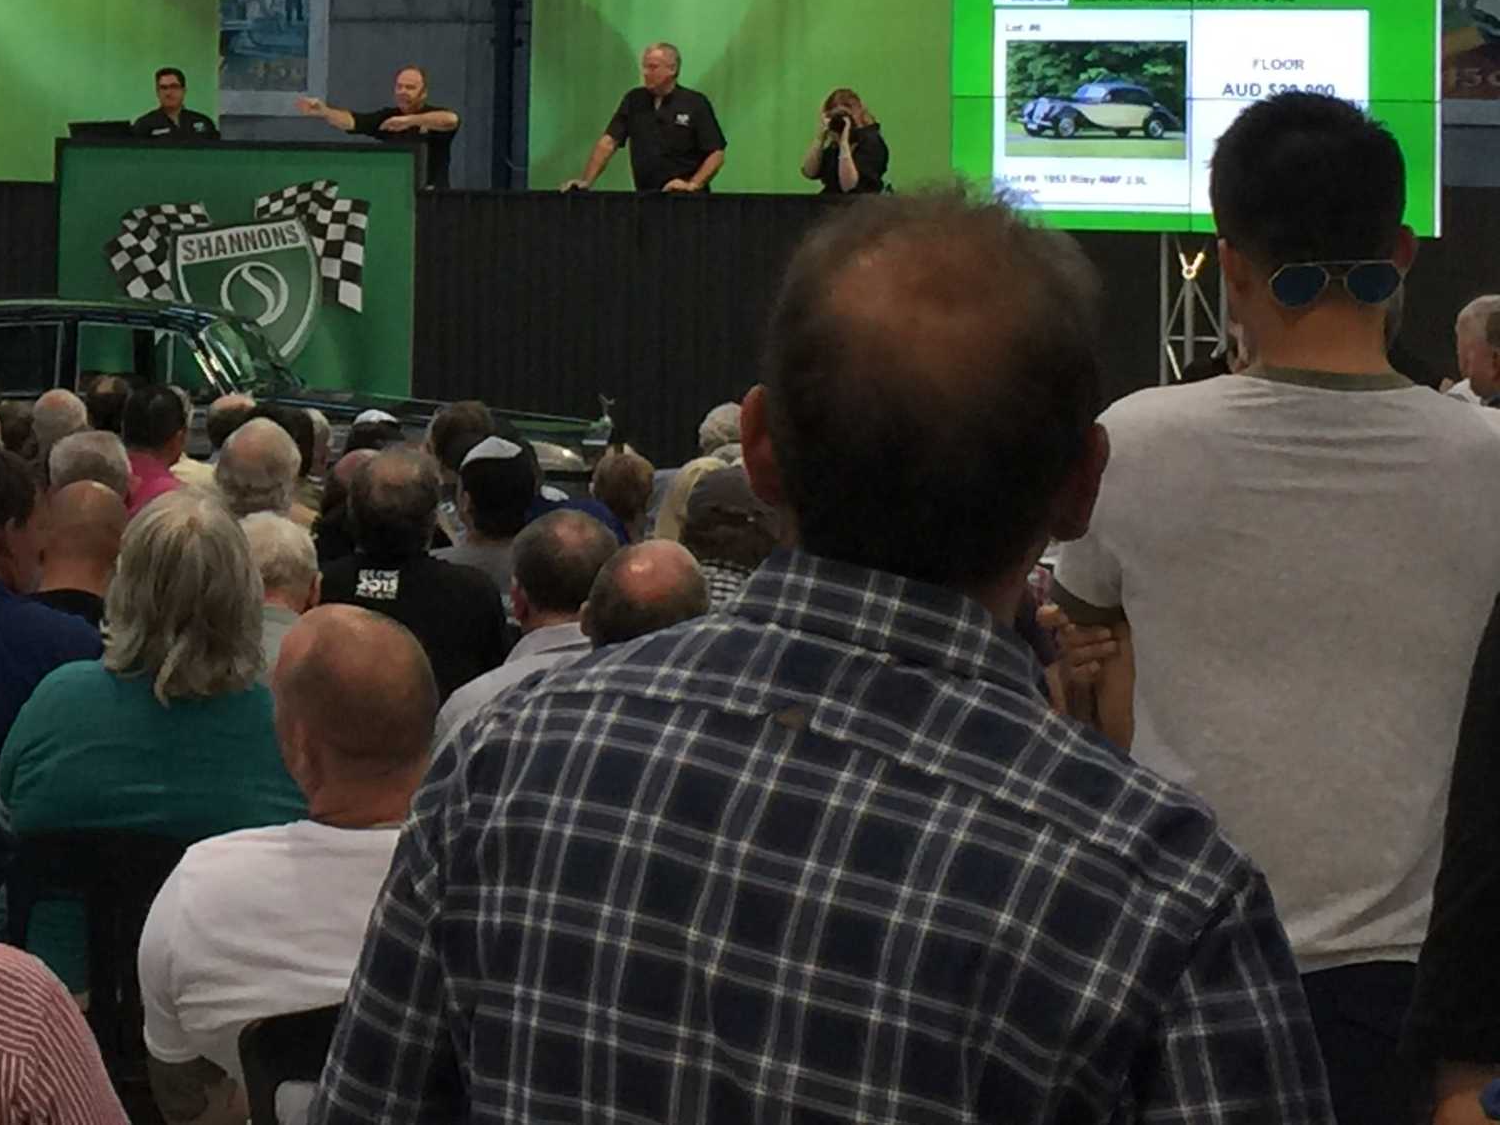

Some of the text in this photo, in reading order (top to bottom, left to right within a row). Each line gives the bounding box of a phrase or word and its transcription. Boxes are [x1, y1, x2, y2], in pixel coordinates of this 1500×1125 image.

[1252, 58, 1305, 71] FLOOR
[1221, 82, 1262, 97] AUD
[181, 223, 300, 263] SHANNONS
